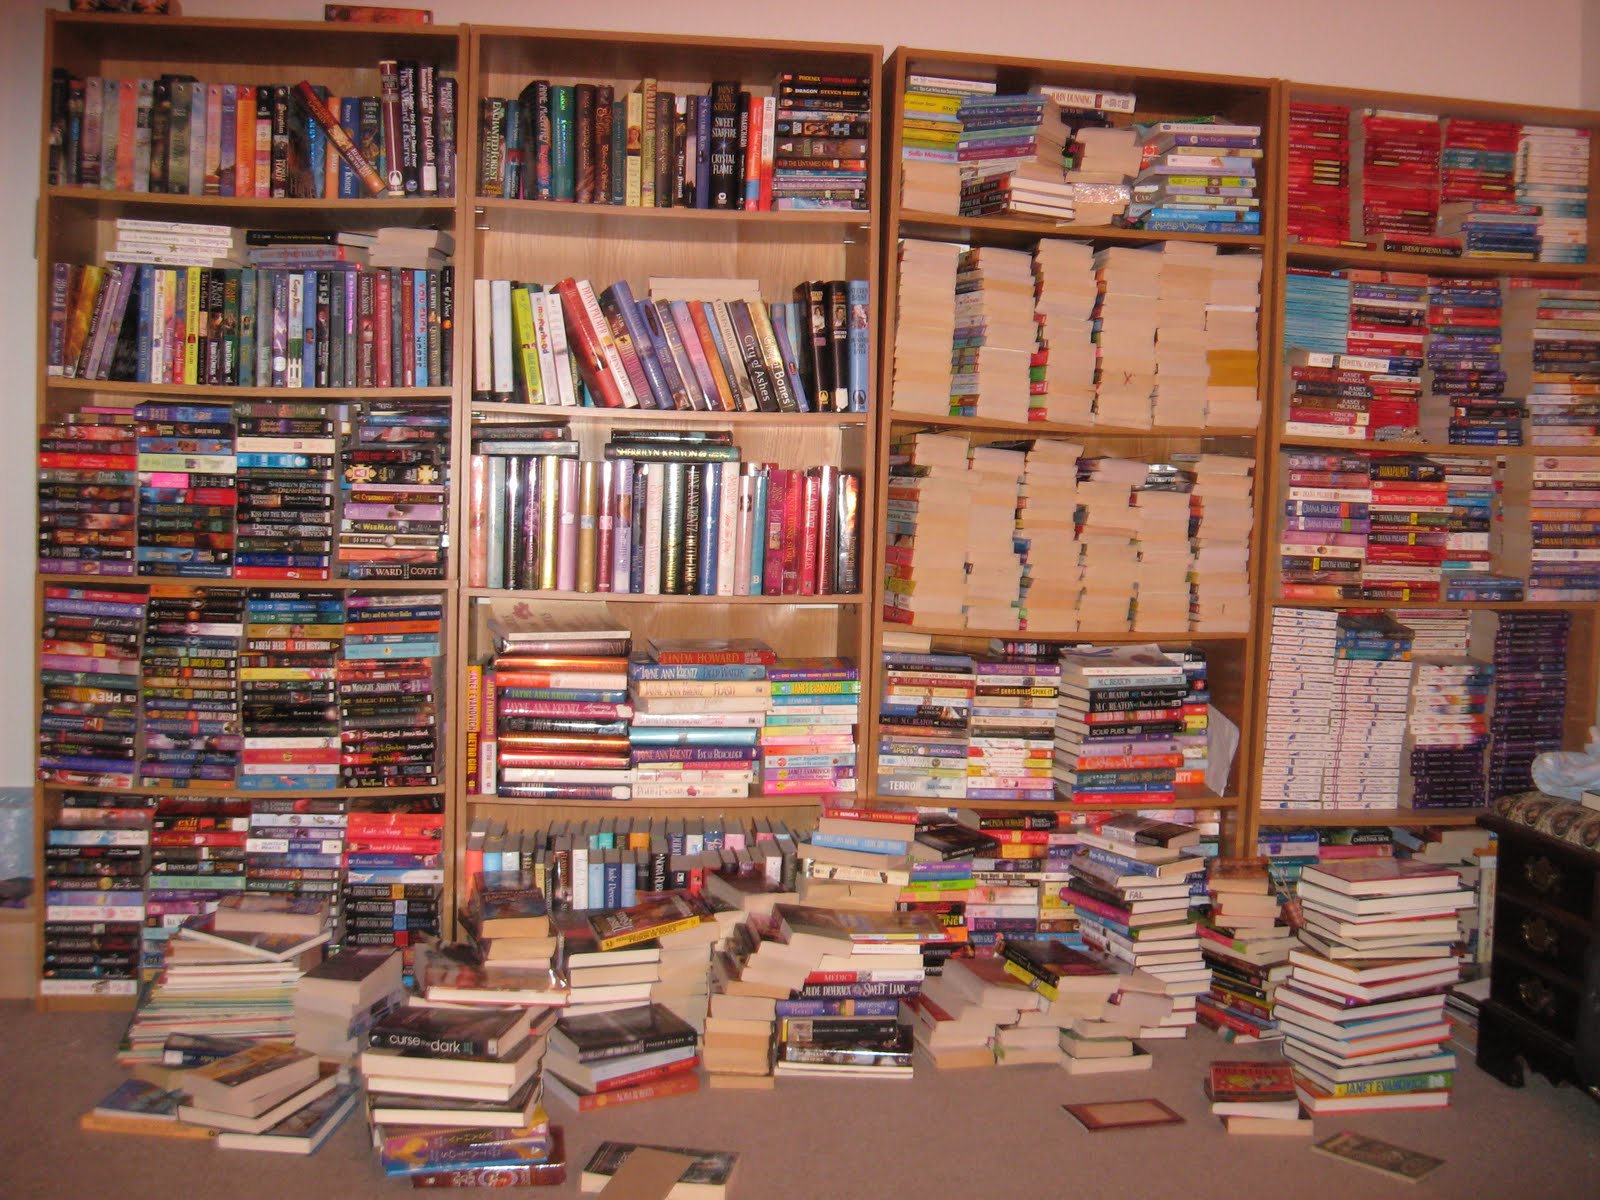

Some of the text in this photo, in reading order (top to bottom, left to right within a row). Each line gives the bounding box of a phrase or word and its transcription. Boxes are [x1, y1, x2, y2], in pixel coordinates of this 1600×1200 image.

[400, 69, 409, 91] The
[401, 92, 410, 124] Wizard
[646, 82, 656, 131] MATILDA
[402, 134, 412, 167] Karres
[418, 283, 427, 333] YOU SUCK
[582, 287, 608, 334] DIANA PALMER
[744, 334, 771, 402] City of Ashes
[763, 335, 778, 360] City
[774, 371, 792, 404] Bones
[662, 448, 698, 458] KENYON
[375, 568, 402, 576] WARD
[410, 567, 438, 576] COVET
[663, 653, 740, 663] LINDA HOWARD
[90, 691, 122, 702] PREY
[811, 684, 843, 694] EVANOVICH
[1108, 691, 1130, 699] BEATON
[468, 671, 478, 731] JANET EVANOVICH
[485, 679, 495, 735] JANET EVANOVICH
[1109, 701, 1134, 710] BEATON
[1092, 727, 1109, 735] SOUR
[467, 733, 477, 775] METRO GIRL
[178, 818, 198, 827] exit
[608, 867, 617, 882] Jude
[1129, 891, 1144, 899] FAL
[802, 985, 822, 997] JUDE
[863, 983, 887, 997] SWEET
[889, 983, 907, 995] LIAR
[389, 1034, 461, 1055] curse dark
[1344, 1076, 1427, 1095] JANET EVANOVICH
